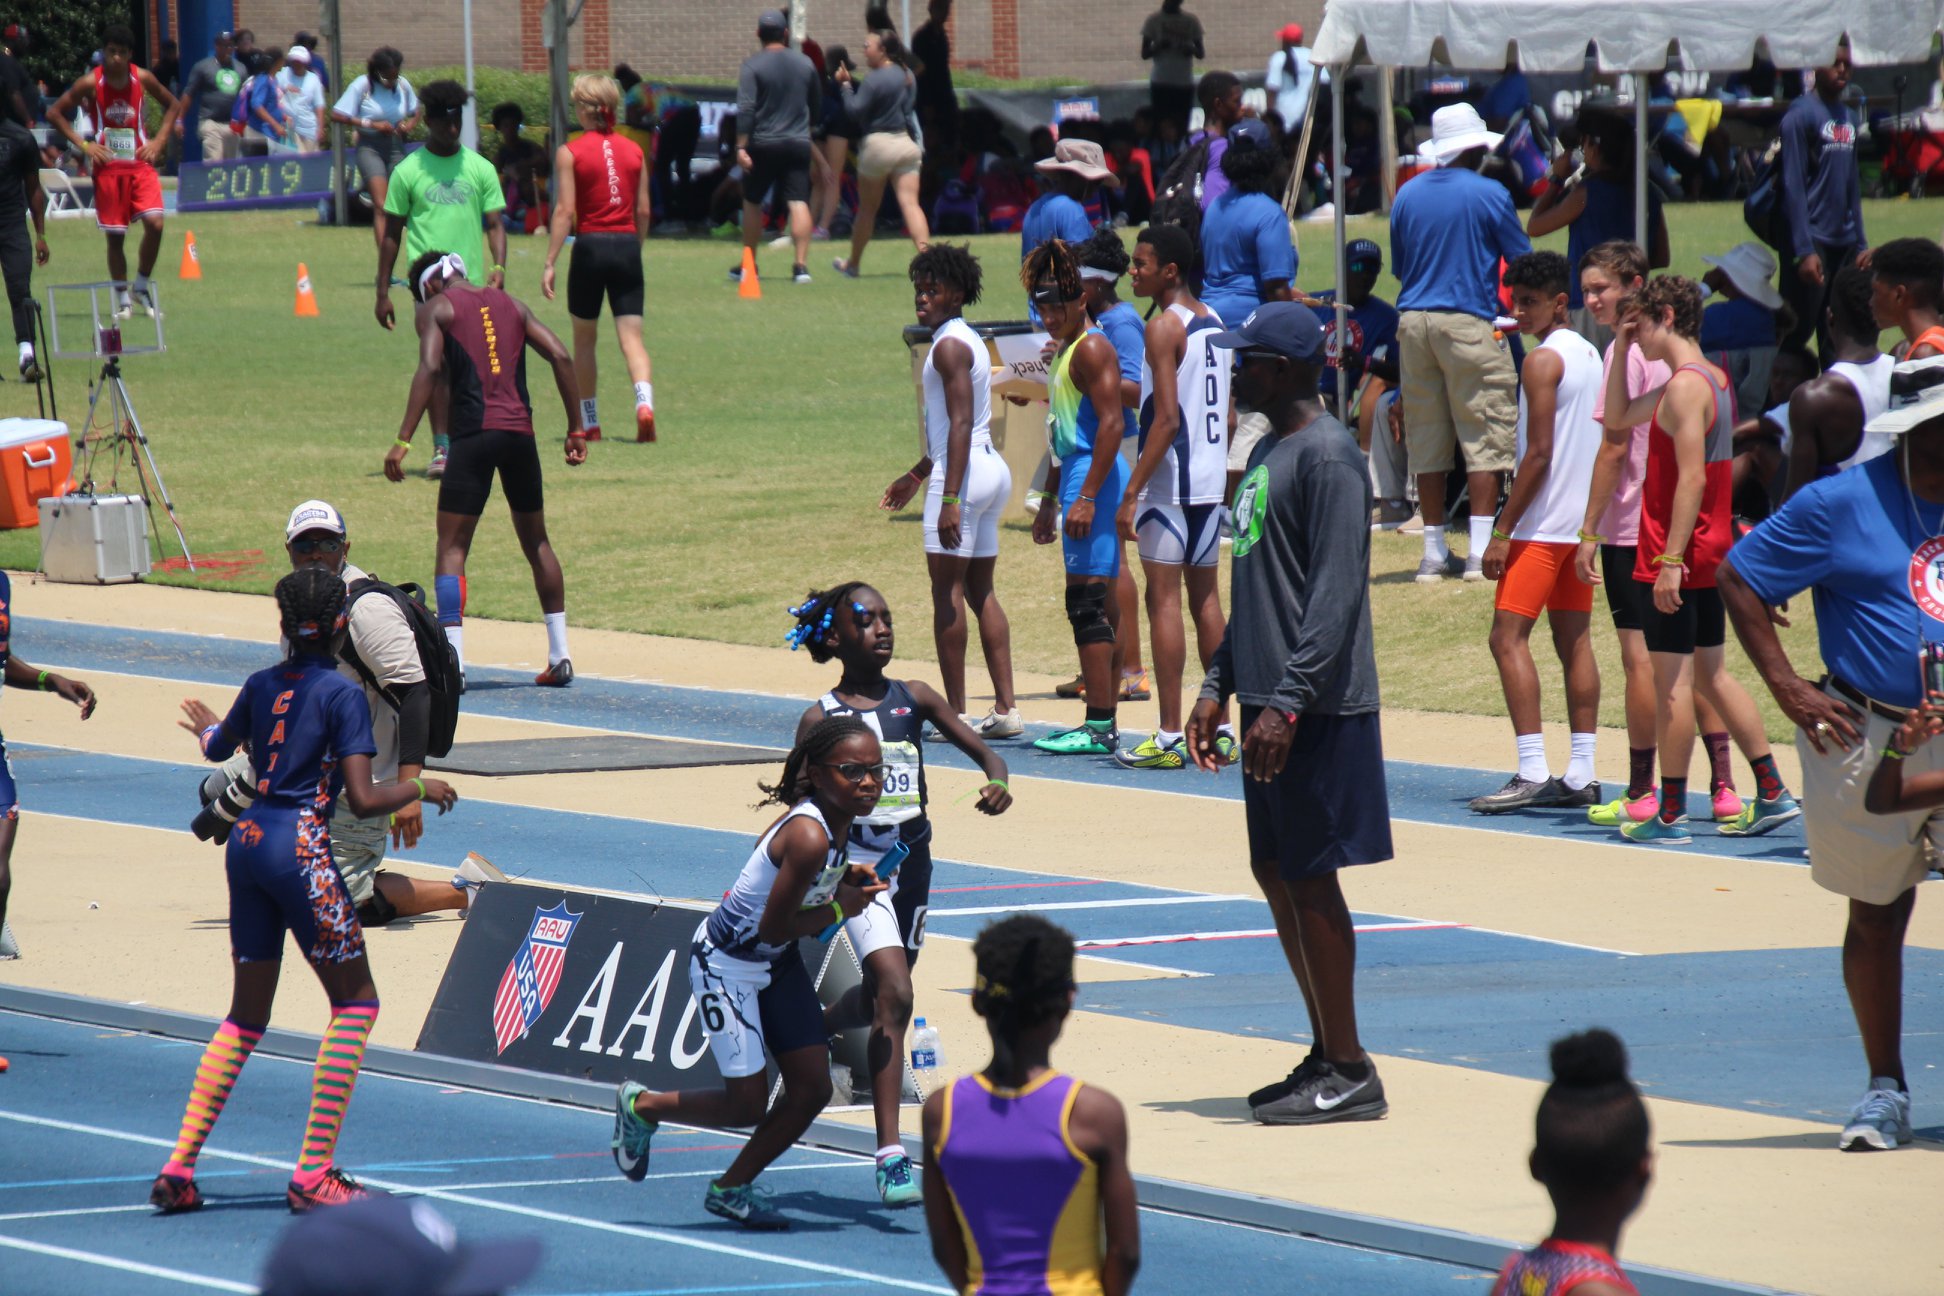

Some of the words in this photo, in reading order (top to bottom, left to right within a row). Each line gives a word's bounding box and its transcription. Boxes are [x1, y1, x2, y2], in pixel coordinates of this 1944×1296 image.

[206, 160, 302, 200] 2019
[602, 139, 622, 205] FREEDOM
[1205, 336, 1221, 444] AOC
[536, 917, 570, 939] AAU
[517, 950, 537, 1021] USA
[700, 993, 726, 1033] 6
